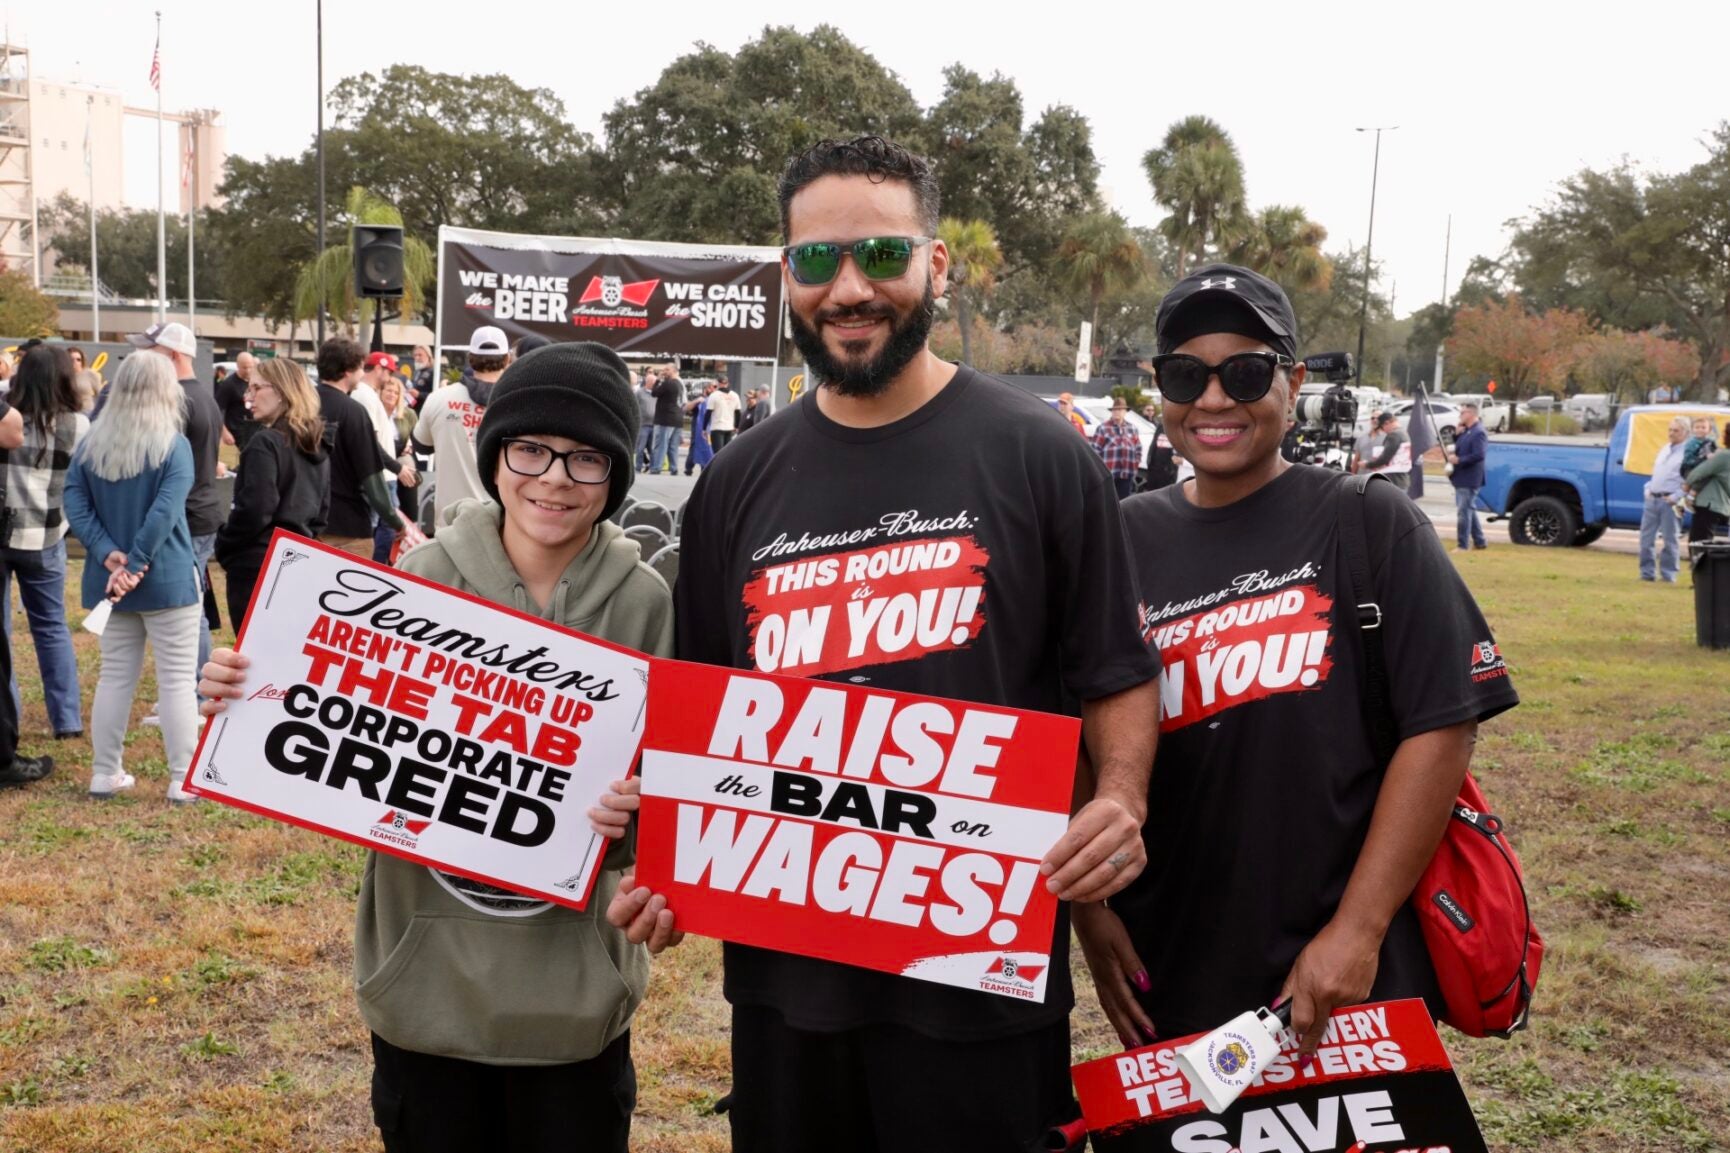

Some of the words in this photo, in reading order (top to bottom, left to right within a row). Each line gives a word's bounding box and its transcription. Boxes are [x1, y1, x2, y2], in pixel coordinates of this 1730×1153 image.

[459, 271, 497, 289] WE
[502, 274, 569, 293] MAKE
[465, 291, 493, 308] the
[494, 289, 569, 323] BEER
[664, 283, 704, 300] WE
[708, 284, 767, 302] CALL
[573, 315, 648, 328] TEAMSTERS
[666, 303, 691, 318] the
[691, 302, 766, 329] SHOTS
[448, 401, 471, 412] WE
[765, 558, 840, 596] THIS
[844, 541, 961, 583] ROUND
[851, 582, 874, 600] is
[318, 568, 620, 702] Teamsters
[754, 605, 832, 673] ON
[847, 585, 983, 658] YOU!
[1152, 620, 1194, 651] HIS
[1194, 590, 1306, 639] ROUND
[1201, 634, 1220, 652] is
[307, 613, 422, 669] AREN'T
[421, 653, 550, 716] PICKING
[549, 694, 594, 728] UP
[1159, 660, 1185, 721] N
[1196, 630, 1329, 707] YOU!
[302, 643, 438, 722] THE
[450, 697, 583, 767] TAB
[283, 684, 573, 802] CORPORATE
[707, 674, 1019, 799] RAISE
[264, 720, 556, 847] GREED
[713, 773, 762, 798] the
[770, 770, 937, 839] BAR
[949, 815, 992, 837] on
[369, 829, 417, 849] TEAMSTERS
[673, 803, 1041, 945] WAGES!
[1439, 893, 1456, 912] Calvin
[1454, 910, 1468, 926] Klein
[980, 981, 1035, 998] TEAMSTERS
[1224, 1032, 1256, 1059] TEAMSTERS
[1171, 1089, 1406, 1153] SAVE
